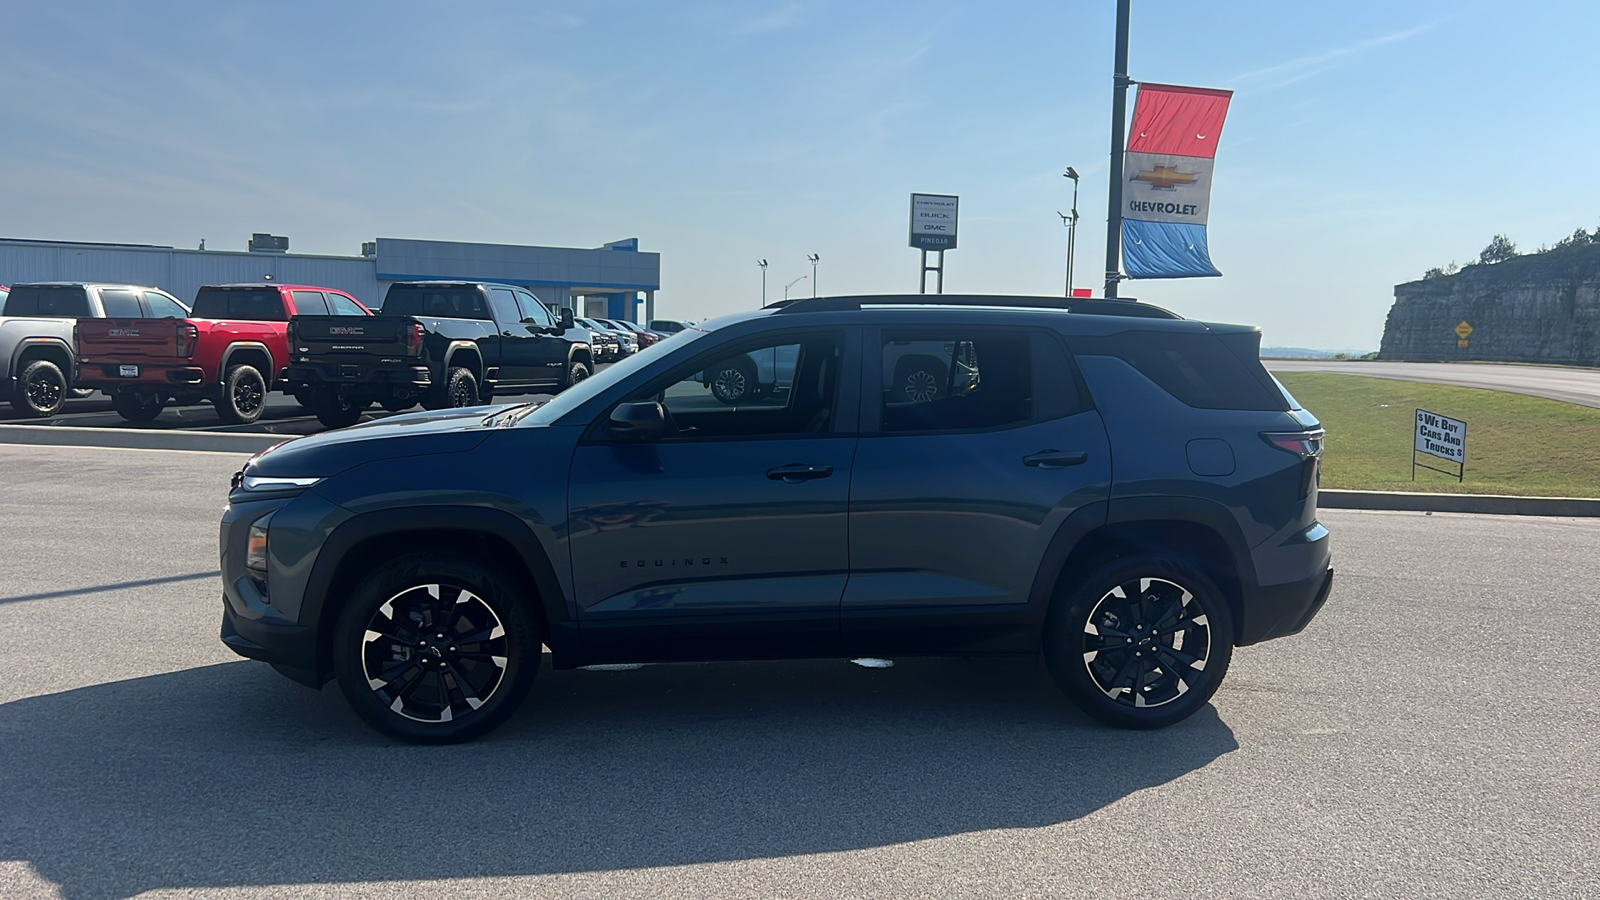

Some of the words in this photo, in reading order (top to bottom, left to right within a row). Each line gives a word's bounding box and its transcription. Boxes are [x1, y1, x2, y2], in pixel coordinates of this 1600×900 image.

[1129, 200, 1197, 215] CHEVROLET
[920, 237, 948, 245] PINEGAR
[108, 328, 140, 337] GMC
[329, 326, 364, 335] GMC
[1441, 418, 1458, 433] BUY
[1420, 424, 1442, 441] CARS
[1443, 432, 1461, 446] AND
[1424, 438, 1455, 457] TRUCKS
[620, 557, 728, 568] EQUINOX
